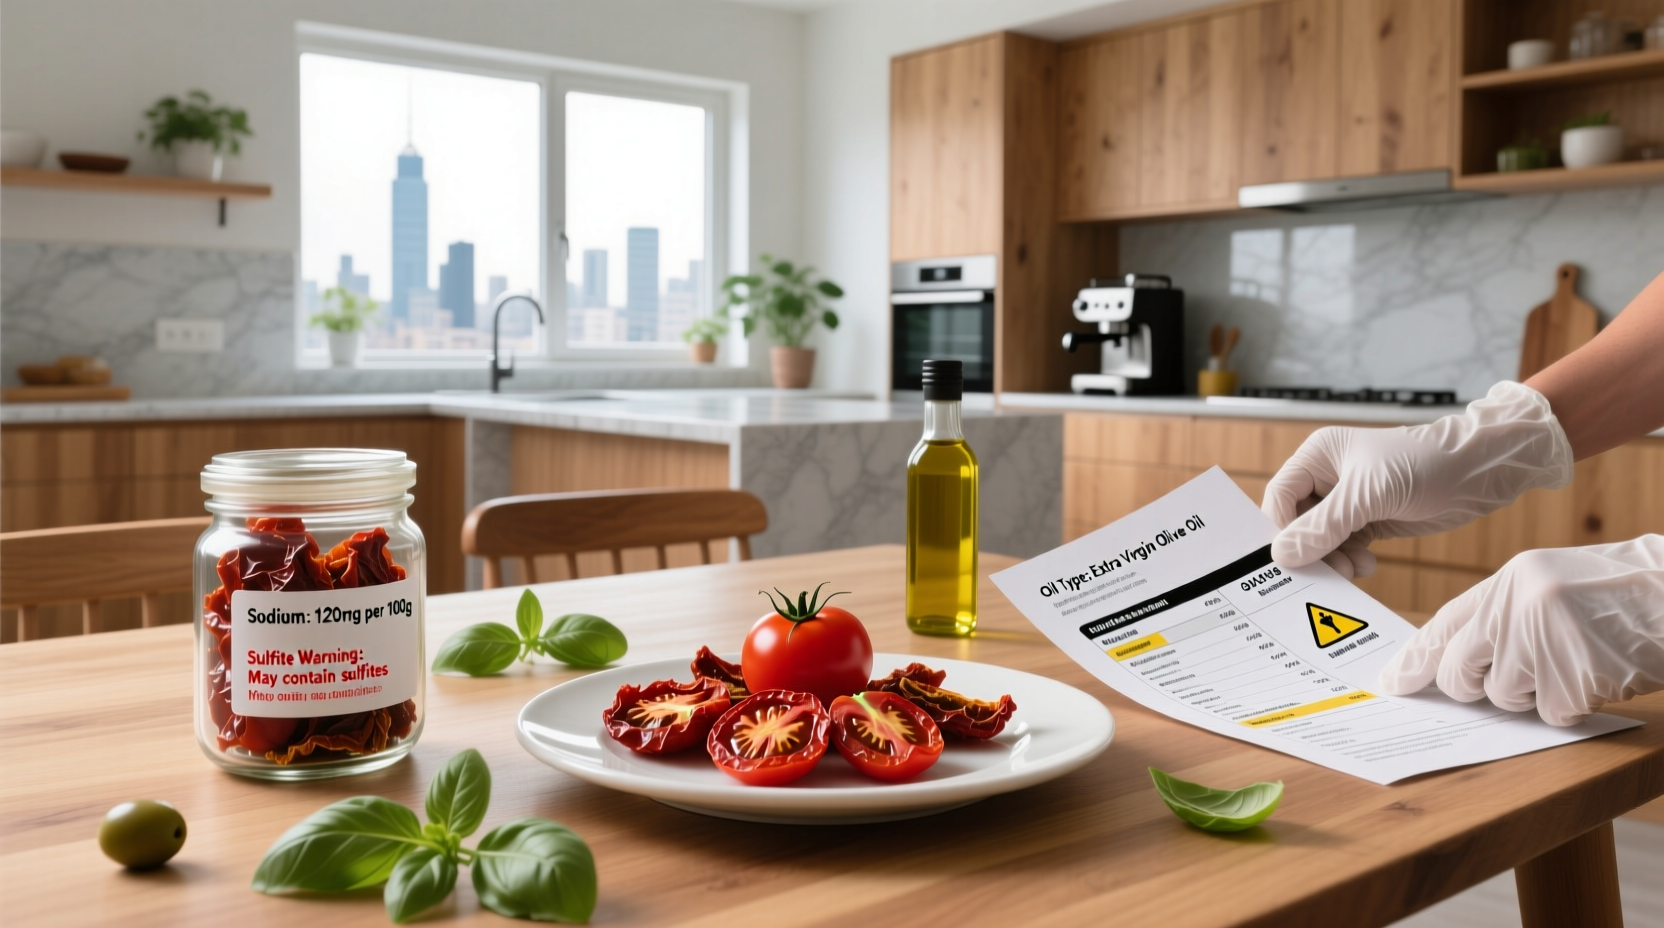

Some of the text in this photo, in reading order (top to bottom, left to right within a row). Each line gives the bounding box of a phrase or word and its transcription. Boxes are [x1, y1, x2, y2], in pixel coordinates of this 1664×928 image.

[1119, 541, 1157, 564] Virgin
[1185, 514, 1205, 531] Oil
[247, 607, 311, 624] Sodium:
[365, 606, 385, 624] per
[387, 598, 412, 617] 100g
[247, 648, 364, 666] Sulfite Warning:
[247, 663, 389, 688] May contain sulfites
